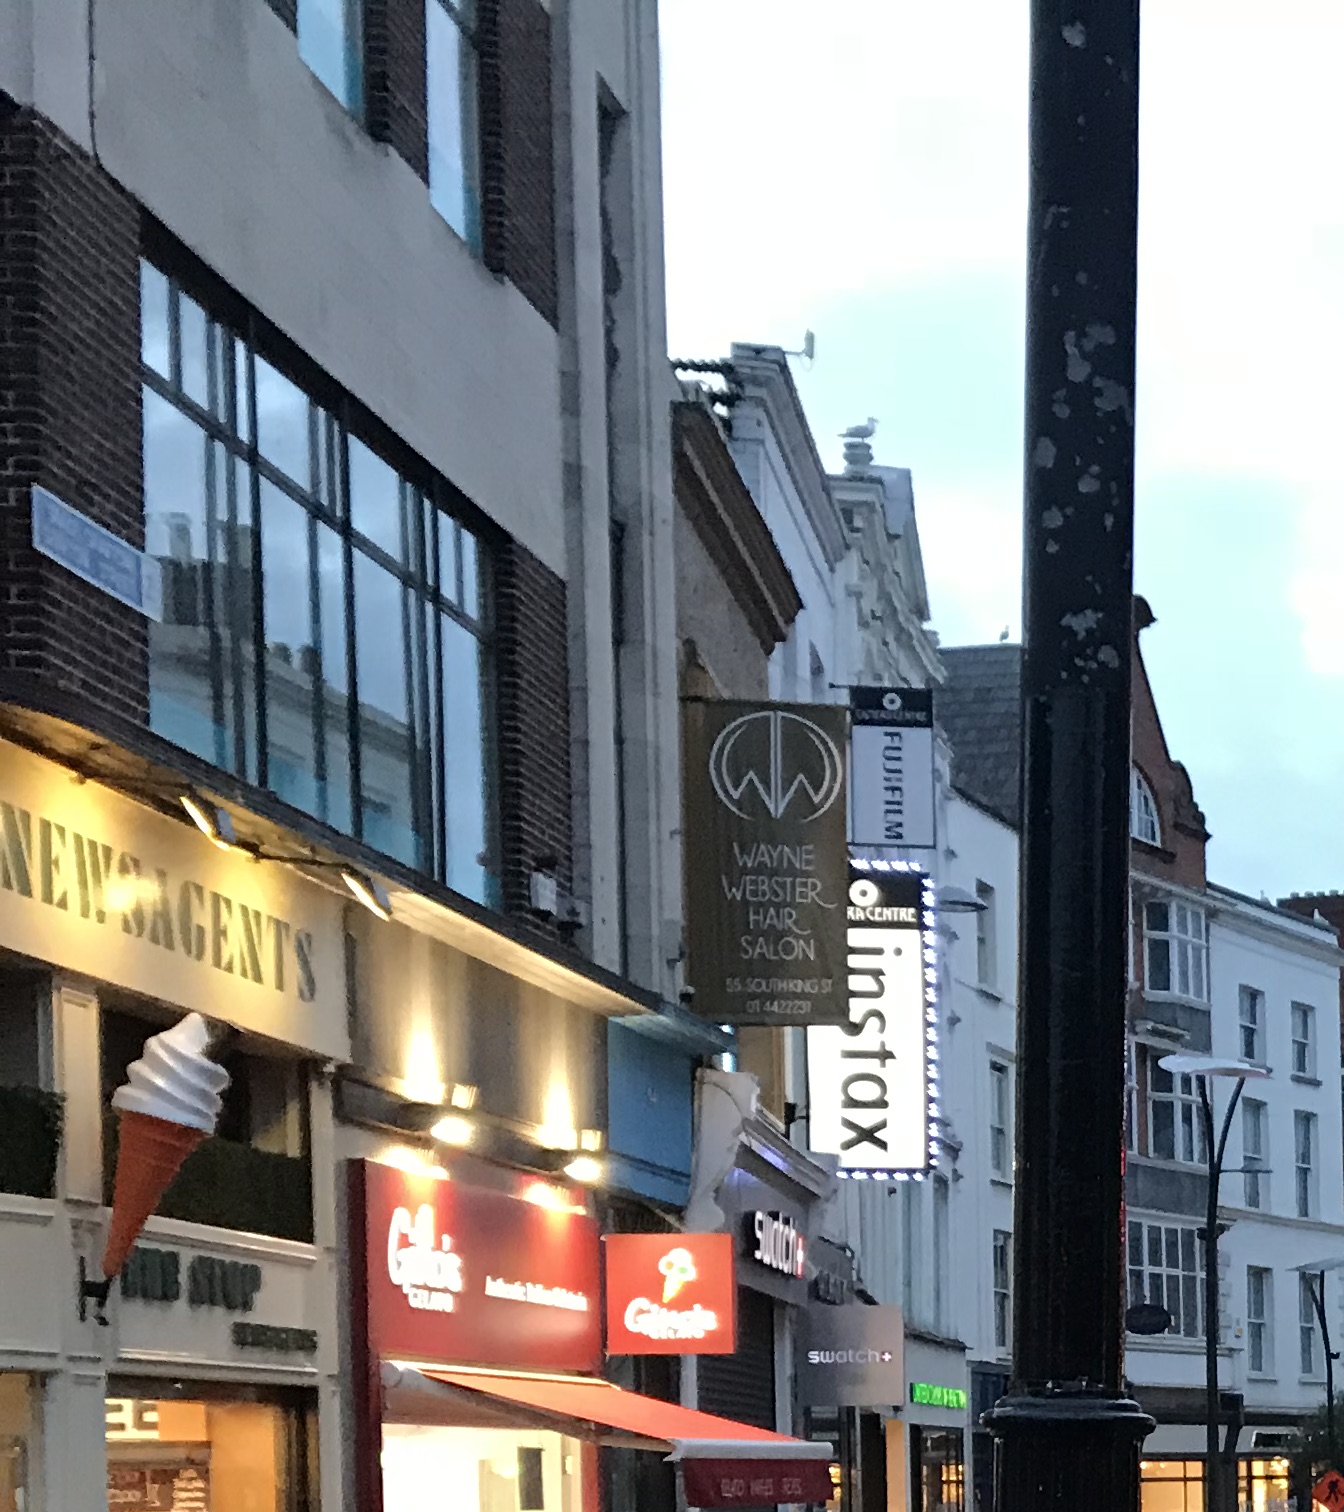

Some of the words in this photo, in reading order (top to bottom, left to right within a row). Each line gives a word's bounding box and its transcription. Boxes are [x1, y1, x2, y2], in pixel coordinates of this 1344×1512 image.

[882, 731, 903, 840] FUJIFILM
[733, 842, 816, 870] WAYNE
[0, 808, 317, 1003] NEWSAGENTS
[721, 876, 838, 910] WEBSTER
[749, 907, 811, 935] HAIR
[867, 907, 917, 923] CENTRE
[740, 934, 816, 962] SALON
[840, 946, 903, 1152] instax
[807, 1349, 880, 1365] swatch
